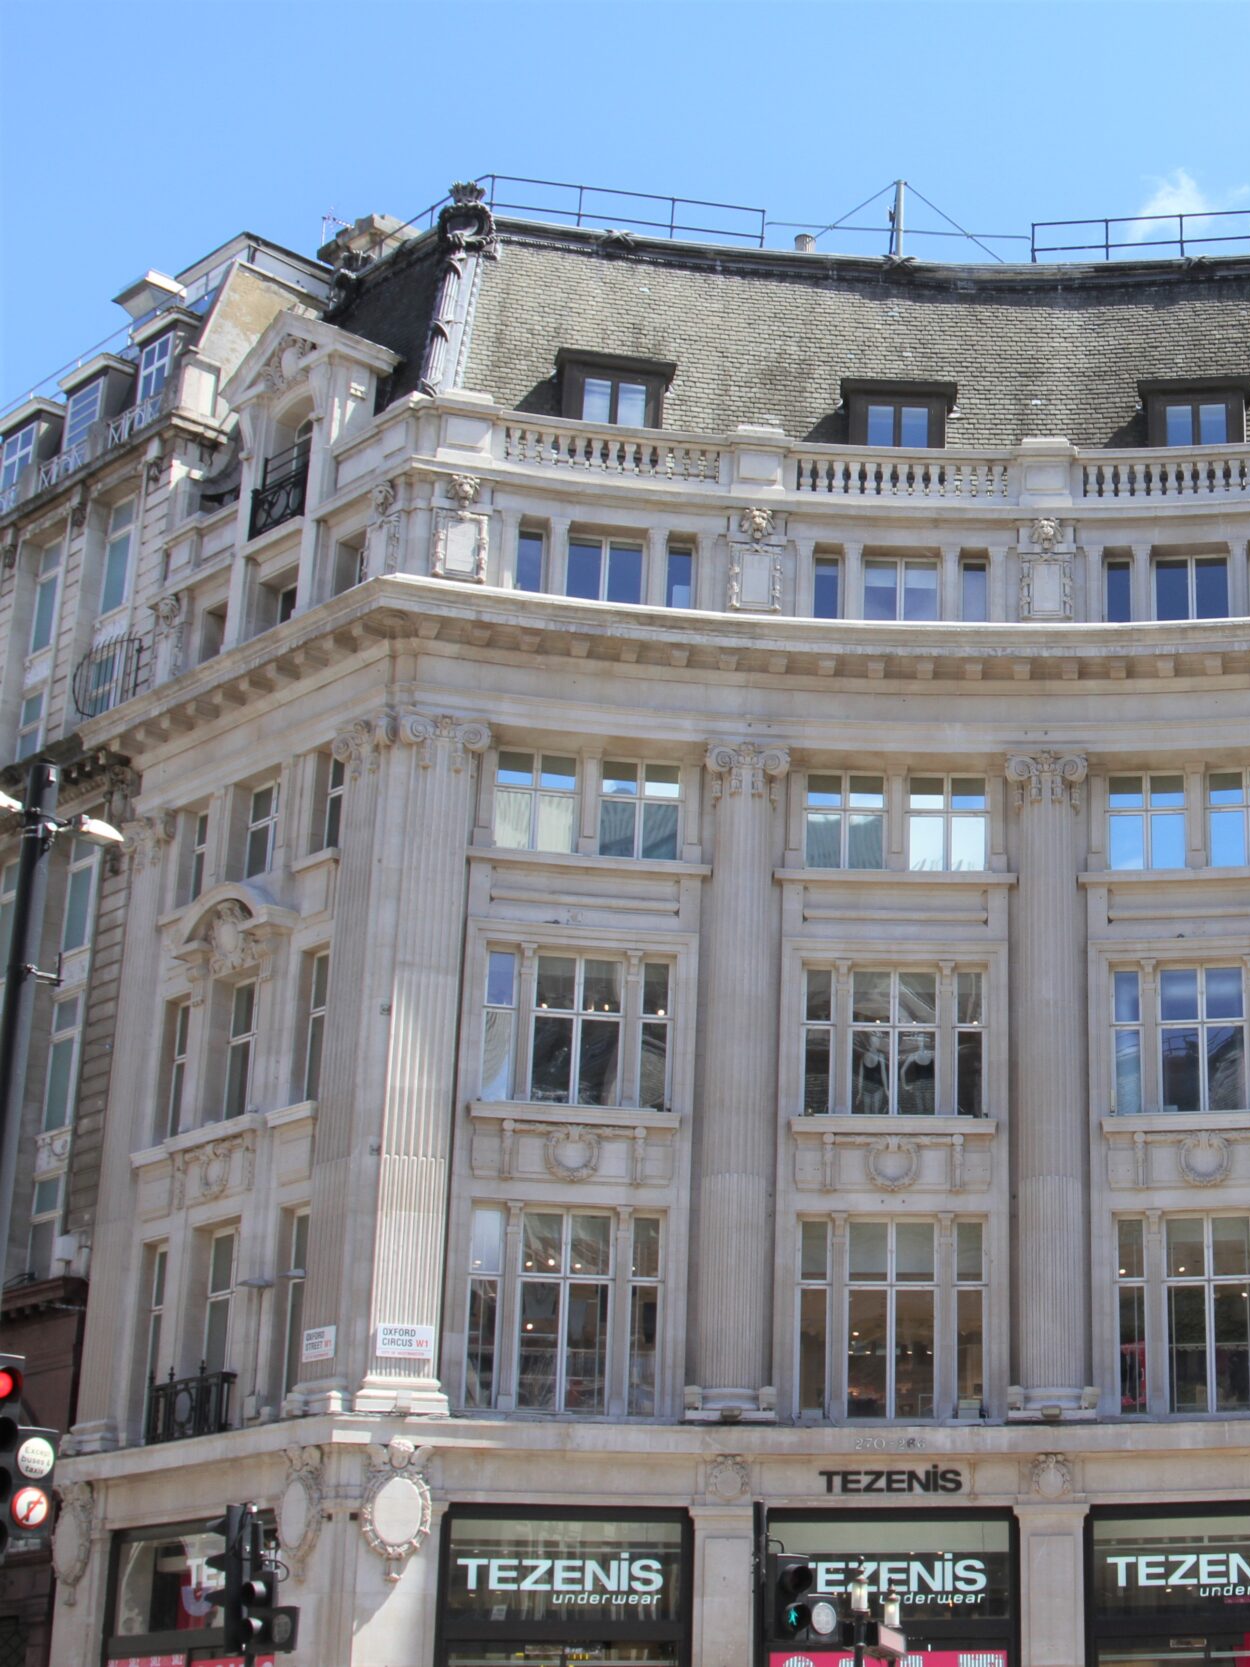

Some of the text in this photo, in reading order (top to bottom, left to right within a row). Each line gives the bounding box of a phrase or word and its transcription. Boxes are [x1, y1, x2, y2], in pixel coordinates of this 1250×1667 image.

[306, 1331, 325, 1342] OXFORD
[382, 1327, 416, 1337] OXFORD
[305, 1341, 323, 1352] STREET
[382, 1337, 429, 1348] CIRCUS W1
[553, 1592, 661, 1605] underwear
